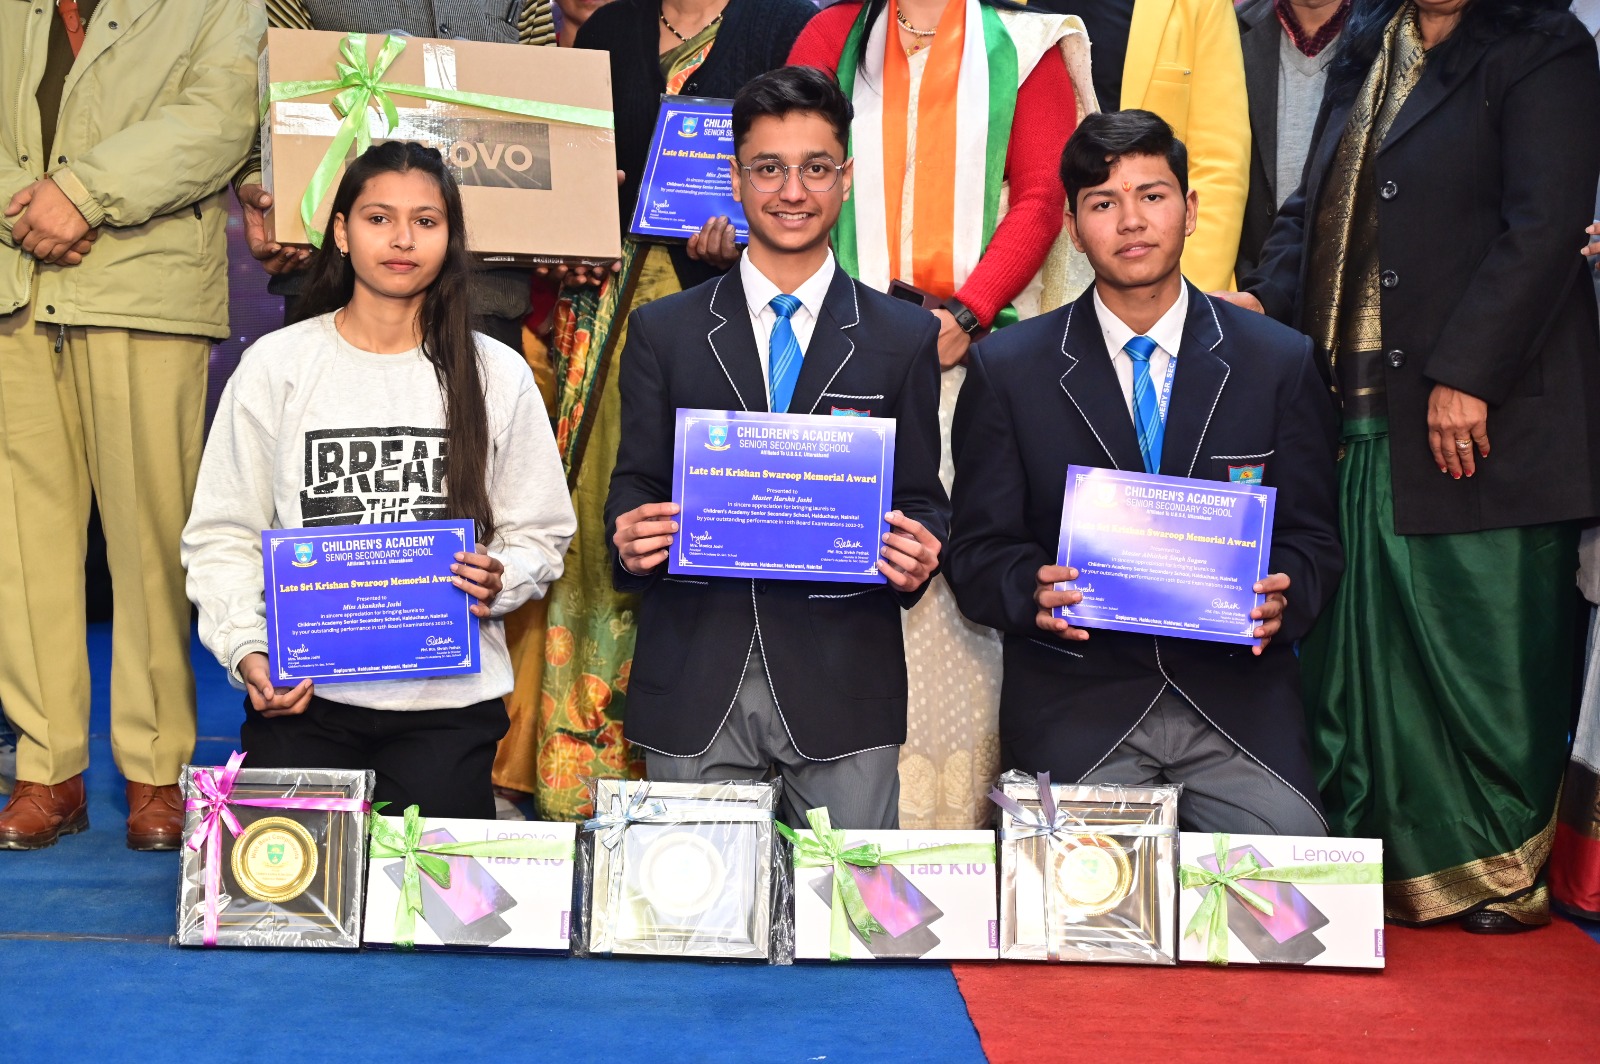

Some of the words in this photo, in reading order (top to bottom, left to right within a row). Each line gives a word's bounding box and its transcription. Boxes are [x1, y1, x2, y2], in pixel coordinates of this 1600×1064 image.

[704, 119, 732, 128] CHILDR
[689, 151, 715, 159] Krishan
[1159, 395, 1167, 423] DEMY
[1167, 360, 1176, 378] SEC.
[736, 426, 798, 440] CHILDREN'S
[802, 429, 854, 442] ACADEMY
[739, 438, 767, 448] SENIOR
[769, 440, 816, 451] SECONDARY
[819, 442, 850, 452] SCHOOL
[689, 466, 708, 475] Late
[710, 467, 723, 476] Sri
[725, 468, 760, 478] Krishan
[762, 470, 800, 481] Swaroop
[803, 472, 844, 482] Memorial
[846, 474, 876, 483] Award
[1124, 485, 1183, 502] CHILDREN'S
[1186, 492, 1236, 507] ACADEMY
[1125, 497, 1153, 508] SENIOR
[1154, 500, 1199, 513] SECONDARY
[1202, 505, 1232, 517] SCHOOL
[322, 538, 382, 552] CHILDREN'S
[386, 535, 435, 548] ACADEMY
[1146, 528, 1183, 541] Swaroop
[1185, 532, 1225, 545] Memorial
[1226, 537, 1256, 548] Award
[325, 552, 353, 561] SENIOR
[355, 549, 400, 559] SECONDARY
[402, 547, 433, 557] SCHOOL
[280, 583, 298, 592] Late
[300, 582, 313, 591] Sri
[315, 580, 349, 590] Krishan
[351, 578, 388, 589] Swaroop
[390, 576, 430, 585] Memorial
[432, 575, 455, 583] Awa
[1293, 845, 1364, 863] Lenovo
